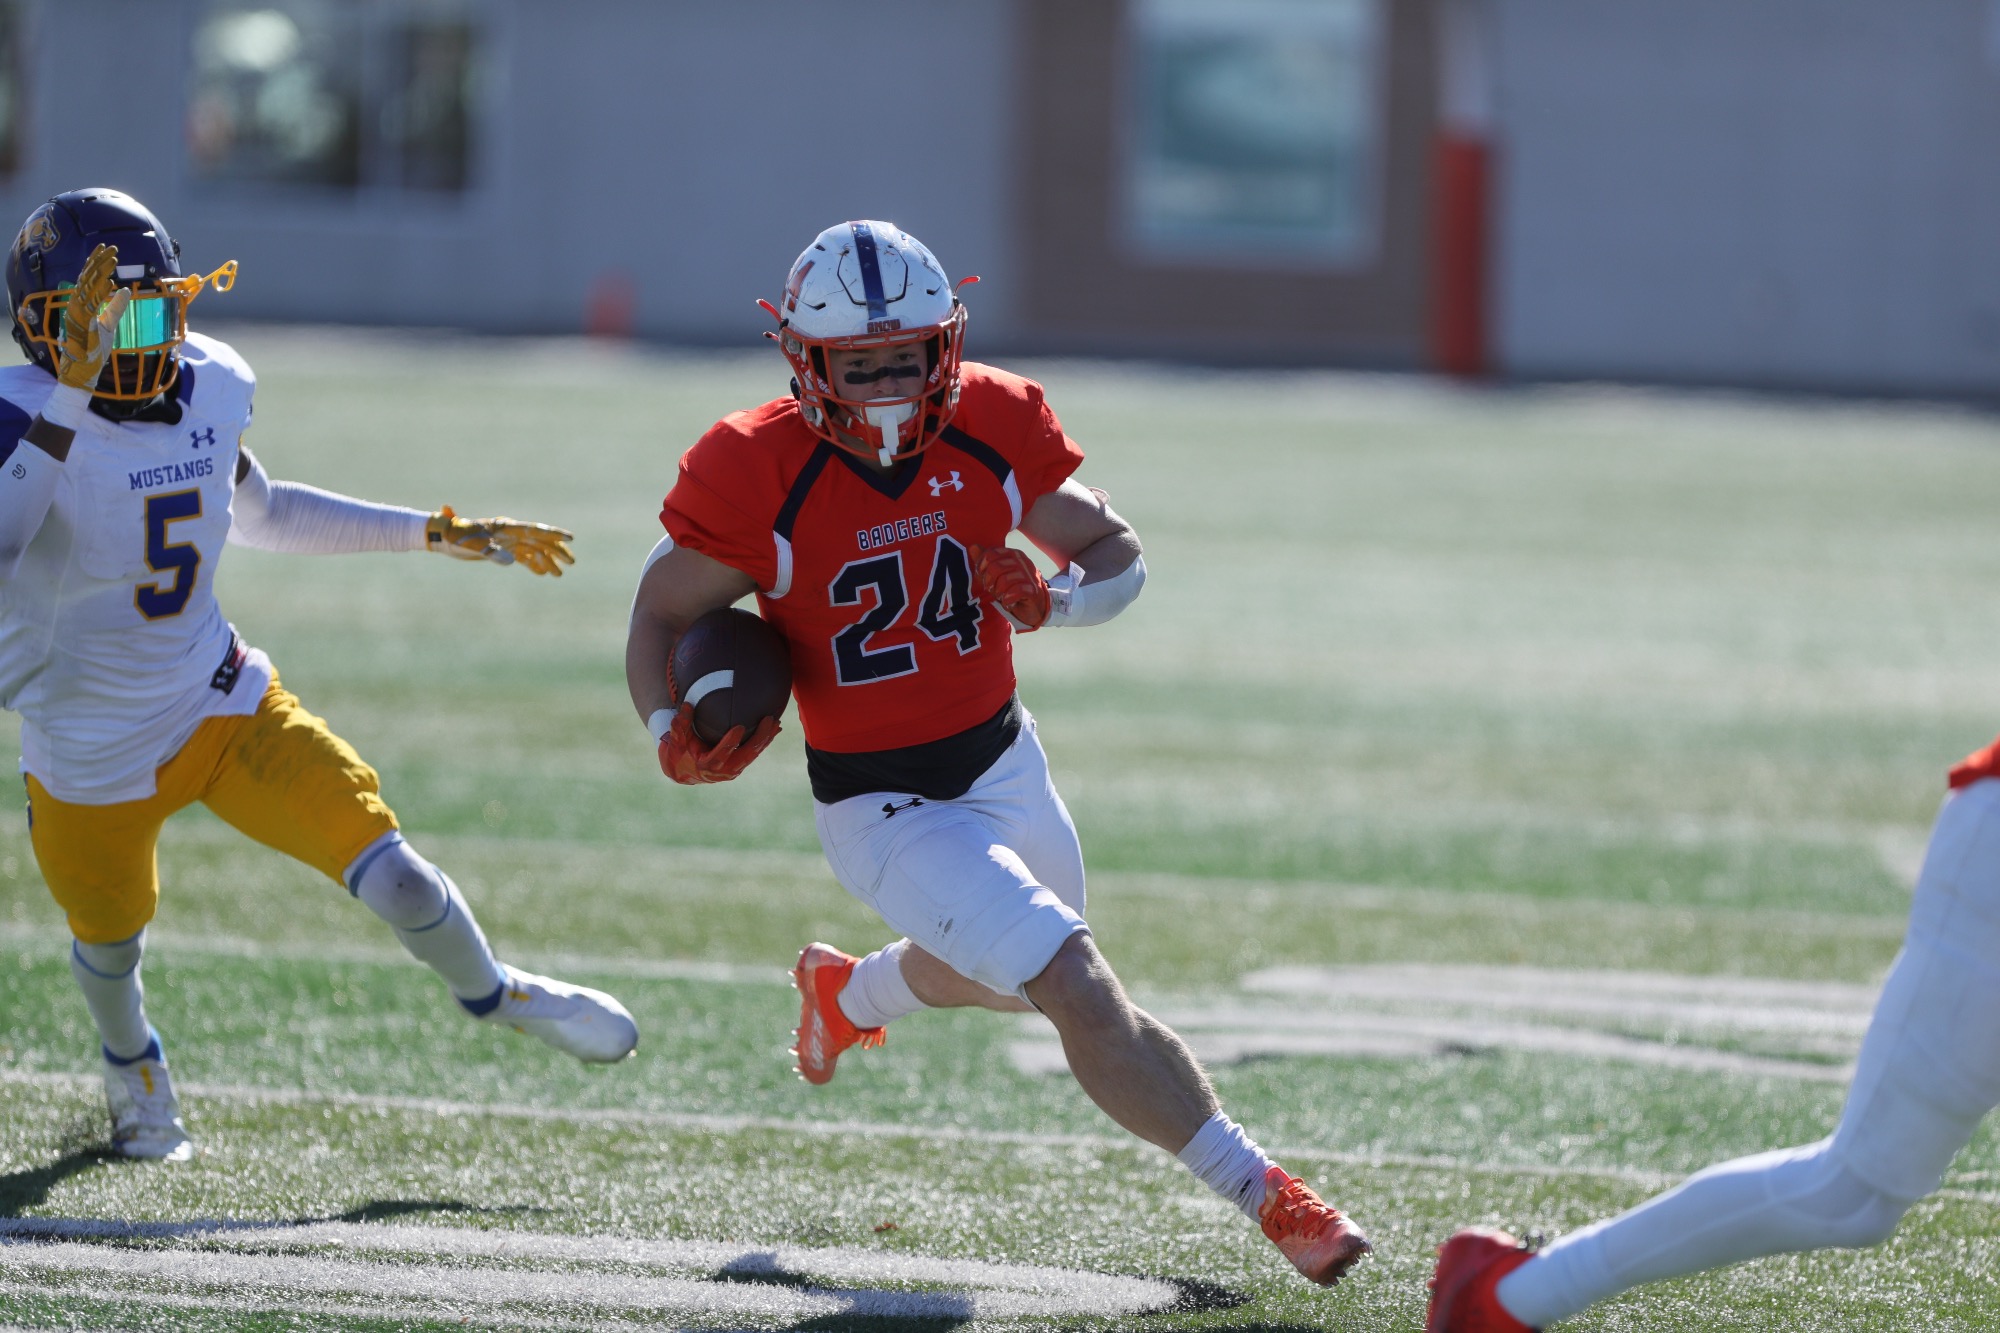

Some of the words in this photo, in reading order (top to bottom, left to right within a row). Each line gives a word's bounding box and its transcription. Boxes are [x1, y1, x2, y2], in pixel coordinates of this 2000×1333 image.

[128, 457, 213, 490] MUSTANGS
[133, 487, 203, 621] 5
[857, 510, 947, 550] BADGERS
[828, 533, 984, 687] 24
